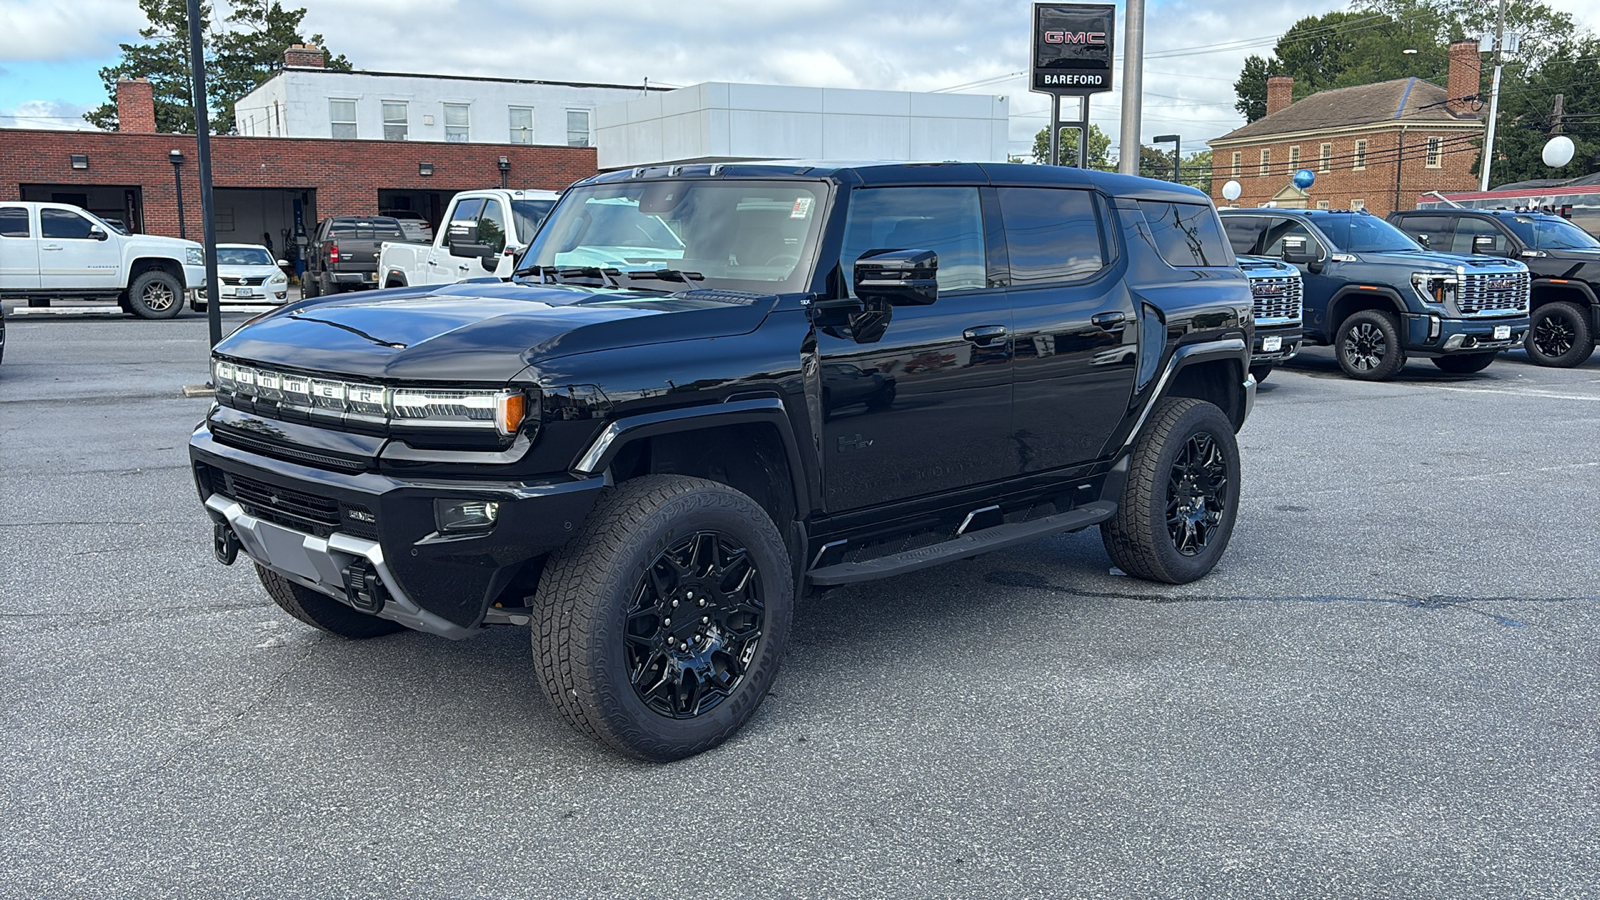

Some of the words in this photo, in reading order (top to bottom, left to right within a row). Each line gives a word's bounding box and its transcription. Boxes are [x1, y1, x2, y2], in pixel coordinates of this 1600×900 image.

[1045, 31, 1106, 44] GMC
[1044, 74, 1103, 85] BAREFORD
[222, 369, 371, 402] HUMMER
[348, 510, 376, 523] GMC
